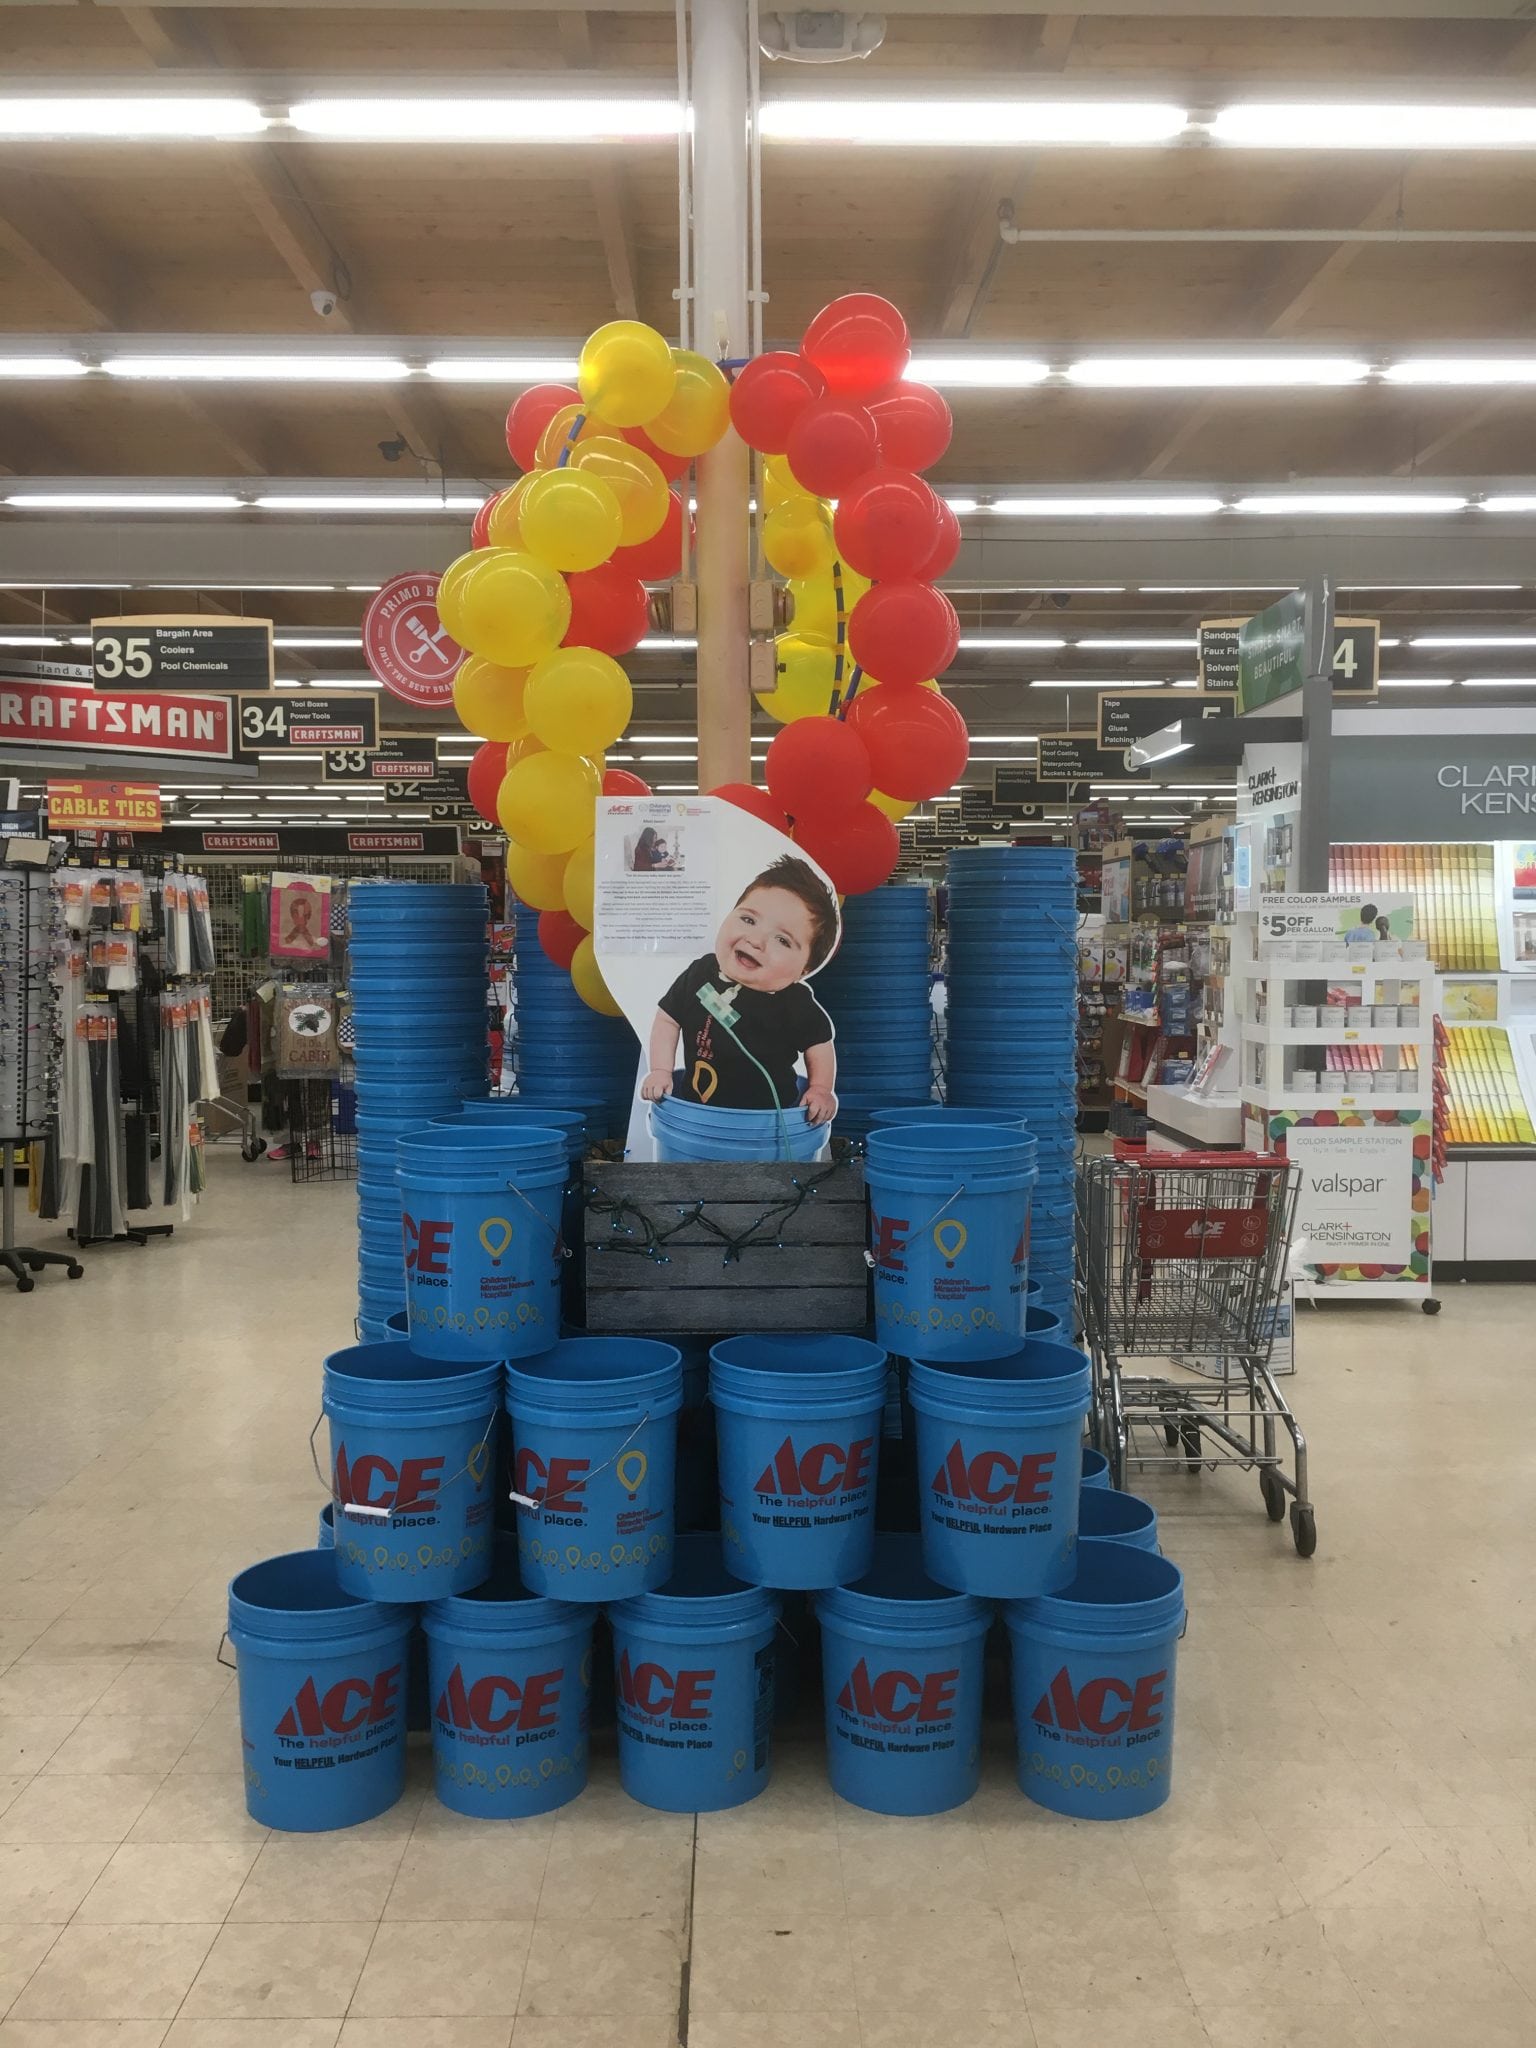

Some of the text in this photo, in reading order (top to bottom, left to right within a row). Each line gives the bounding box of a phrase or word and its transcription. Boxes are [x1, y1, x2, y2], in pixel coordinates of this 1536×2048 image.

[380, 586, 420, 618] PRIMO
[156, 629, 214, 639] Bargain Area
[95, 637, 153, 679] 35
[160, 646, 195, 654] Coolers
[1203, 648, 1225, 656] Faux
[1333, 638, 1358, 678] 4
[36, 663, 70, 675] Hand
[160, 662, 229, 670] Pool Chemicals
[378, 646, 393, 668] ONLY
[392, 667, 408, 684] THE
[408, 681, 432, 693] BEST
[1254, 648, 1296, 680] BEAUTIFUL.
[1207, 679, 1234, 687] Stains
[1104, 700, 1120, 709] Tape
[242, 706, 287, 738] 34
[294, 729, 359, 740] CRAFTSMAN
[1104, 736, 1134, 745] Patching
[328, 750, 366, 772] 33
[375, 765, 430, 773] CRAFTSMAN
[1252, 780, 1298, 807] KENSINGTON
[50, 797, 157, 818] CABLE TIES
[1, 822, 19, 830] HIGH
[207, 836, 274, 847] CRAFTSMAN
[353, 836, 419, 847] CRAFTSMAN
[1262, 896, 1285, 904] FREE
[1287, 896, 1318, 904] COLOR
[1287, 916, 1314, 926] OFF
[1297, 1137, 1402, 1145] COLOR SAMPLE STATION
[1311, 1172, 1385, 1197] valspar
[1184, 1219, 1226, 1235] ACE
[1310, 1232, 1391, 1241] KENSINGTON
[417, 1274, 453, 1288] place.
[753, 1435, 874, 1496] ACE
[931, 1438, 1057, 1505] ACE
[757, 1494, 783, 1507] The
[787, 1496, 836, 1510] helpful
[934, 1492, 1052, 1519] The helpful place.
[392, 1515, 441, 1530] place.
[544, 1513, 588, 1527] place.
[752, 1512, 771, 1524] Your
[773, 1516, 812, 1528] HELPFUL
[814, 1512, 852, 1526] Hardware
[946, 1517, 982, 1535] HELPFUL
[983, 1523, 1027, 1535] Hardware
[1029, 1523, 1053, 1534] Place
[619, 1647, 716, 1719] ACE
[835, 1656, 960, 1724] ACE
[273, 1663, 401, 1737] ACE
[435, 1662, 564, 1733] ACE
[1031, 1664, 1168, 1736] ACE
[625, 1706, 712, 1733] helpful place.
[839, 1708, 859, 1726] The
[862, 1719, 911, 1735] helpful
[278, 1736, 305, 1749] The
[309, 1732, 362, 1749] helpful
[438, 1722, 560, 1748] The helpful place.
[645, 1734, 713, 1750] Hardware Place
[850, 1732, 886, 1753] HELPFUL
[887, 1741, 931, 1753] Hardware
[1034, 1722, 1061, 1742] The
[1065, 1733, 1121, 1749] helpful
[273, 1755, 293, 1767] Your
[294, 1755, 336, 1770] HELPFUL
[337, 1745, 379, 1765] Hardware
